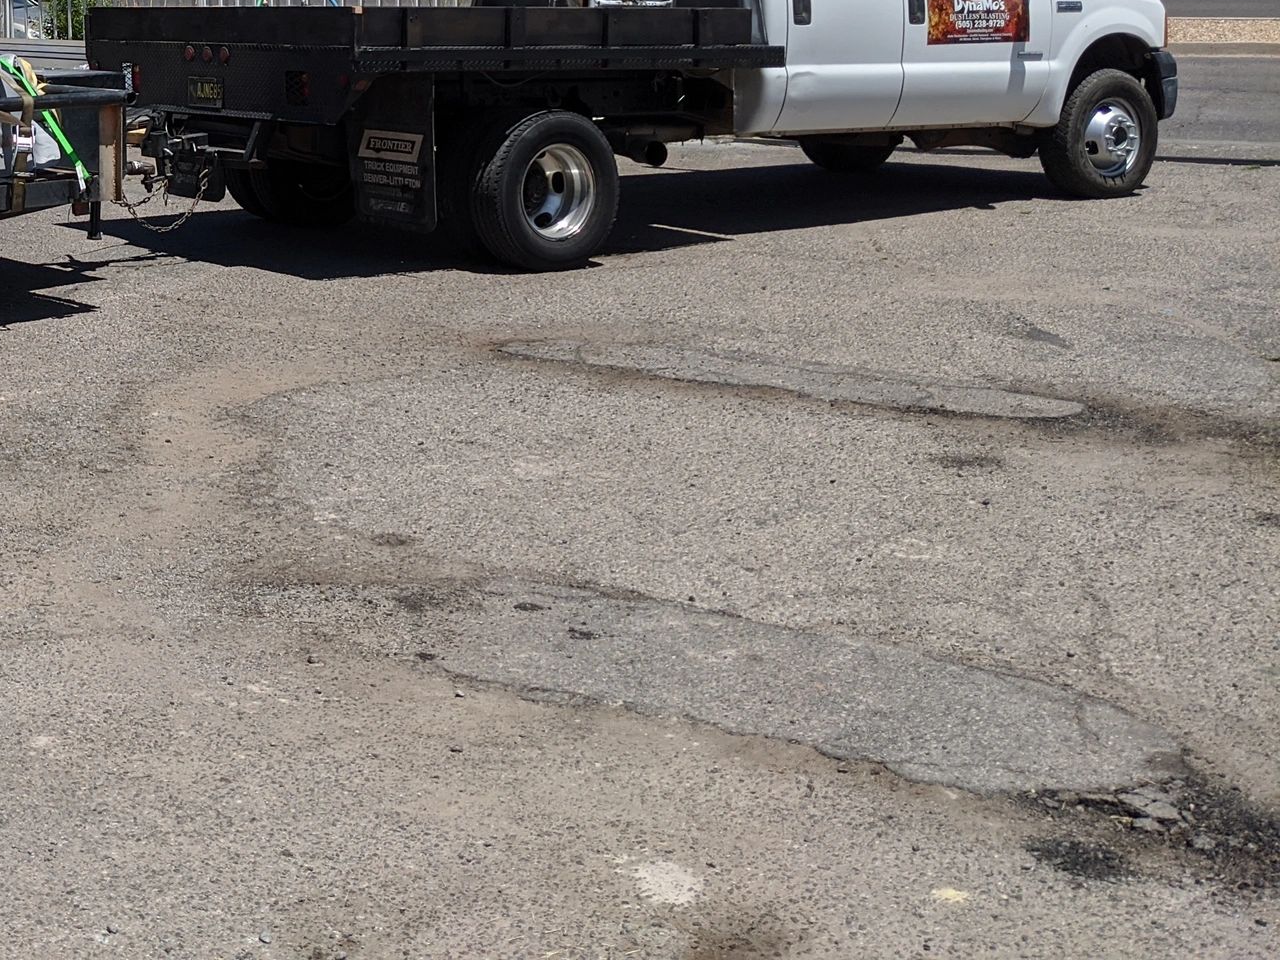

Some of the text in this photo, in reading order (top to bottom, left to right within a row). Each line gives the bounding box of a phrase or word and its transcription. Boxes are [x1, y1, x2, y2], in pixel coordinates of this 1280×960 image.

[949, 12, 1010, 22] DUSTLESS BLASTING
[369, 138, 413, 152] FRONTIER
[364, 160, 419, 175] TRUCK EQUIPMENT
